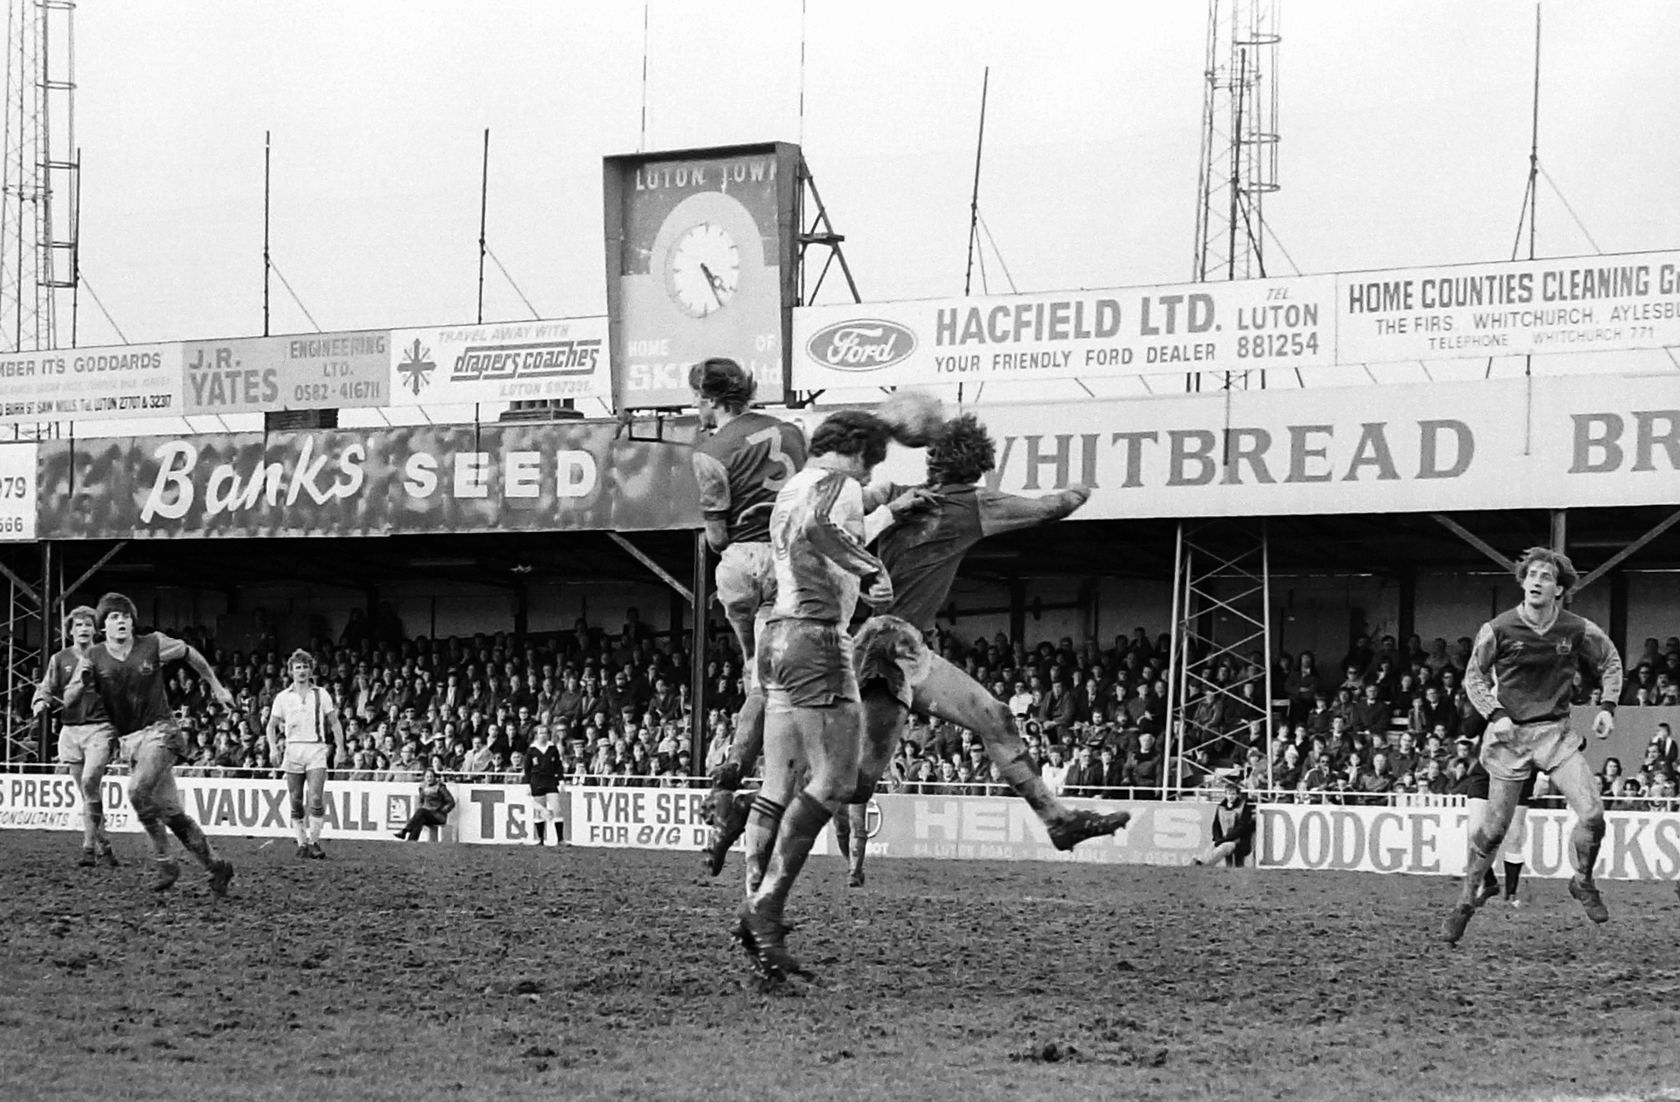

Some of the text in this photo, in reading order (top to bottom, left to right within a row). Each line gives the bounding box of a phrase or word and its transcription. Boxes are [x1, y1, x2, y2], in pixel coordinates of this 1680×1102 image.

[1266, 286, 1290, 301] TEL
[1349, 280, 1414, 314] HOME
[1421, 273, 1534, 308] COUNTIES
[1542, 265, 1650, 302] CLEANING
[935, 293, 1222, 346] HACFIELD LTD.
[1237, 302, 1318, 331] LUTON
[1376, 317, 1407, 335] THE
[438, 323, 570, 343] TRAVEL AWAY WITH
[827, 327, 898, 364] Ford
[1236, 332, 1319, 358] 881254
[1428, 333, 1509, 350] TELEPHONE
[1533, 328, 1622, 346] WHITCHURCH
[189, 348, 241, 369] J.R.
[290, 335, 386, 359] ENGINEERING
[935, 343, 1216, 373] YOUR FRIENDLY FORD DEALER
[74, 352, 162, 373] GODDARDS
[323, 361, 355, 377] LTD.
[190, 368, 279, 406] YATES
[745, 426, 797, 492] 3
[0, 476, 26, 499] 79
[140, 434, 597, 524] Banks SEED
[11, 779, 76, 808] PRESS
[0, 810, 70, 827] ONSULTANTS
[194, 787, 378, 832] VAUXALL
[583, 791, 645, 824] TYRE
[590, 826, 629, 844] FOR
[636, 825, 681, 845] BIG
[1259, 808, 1442, 874] DODGE
